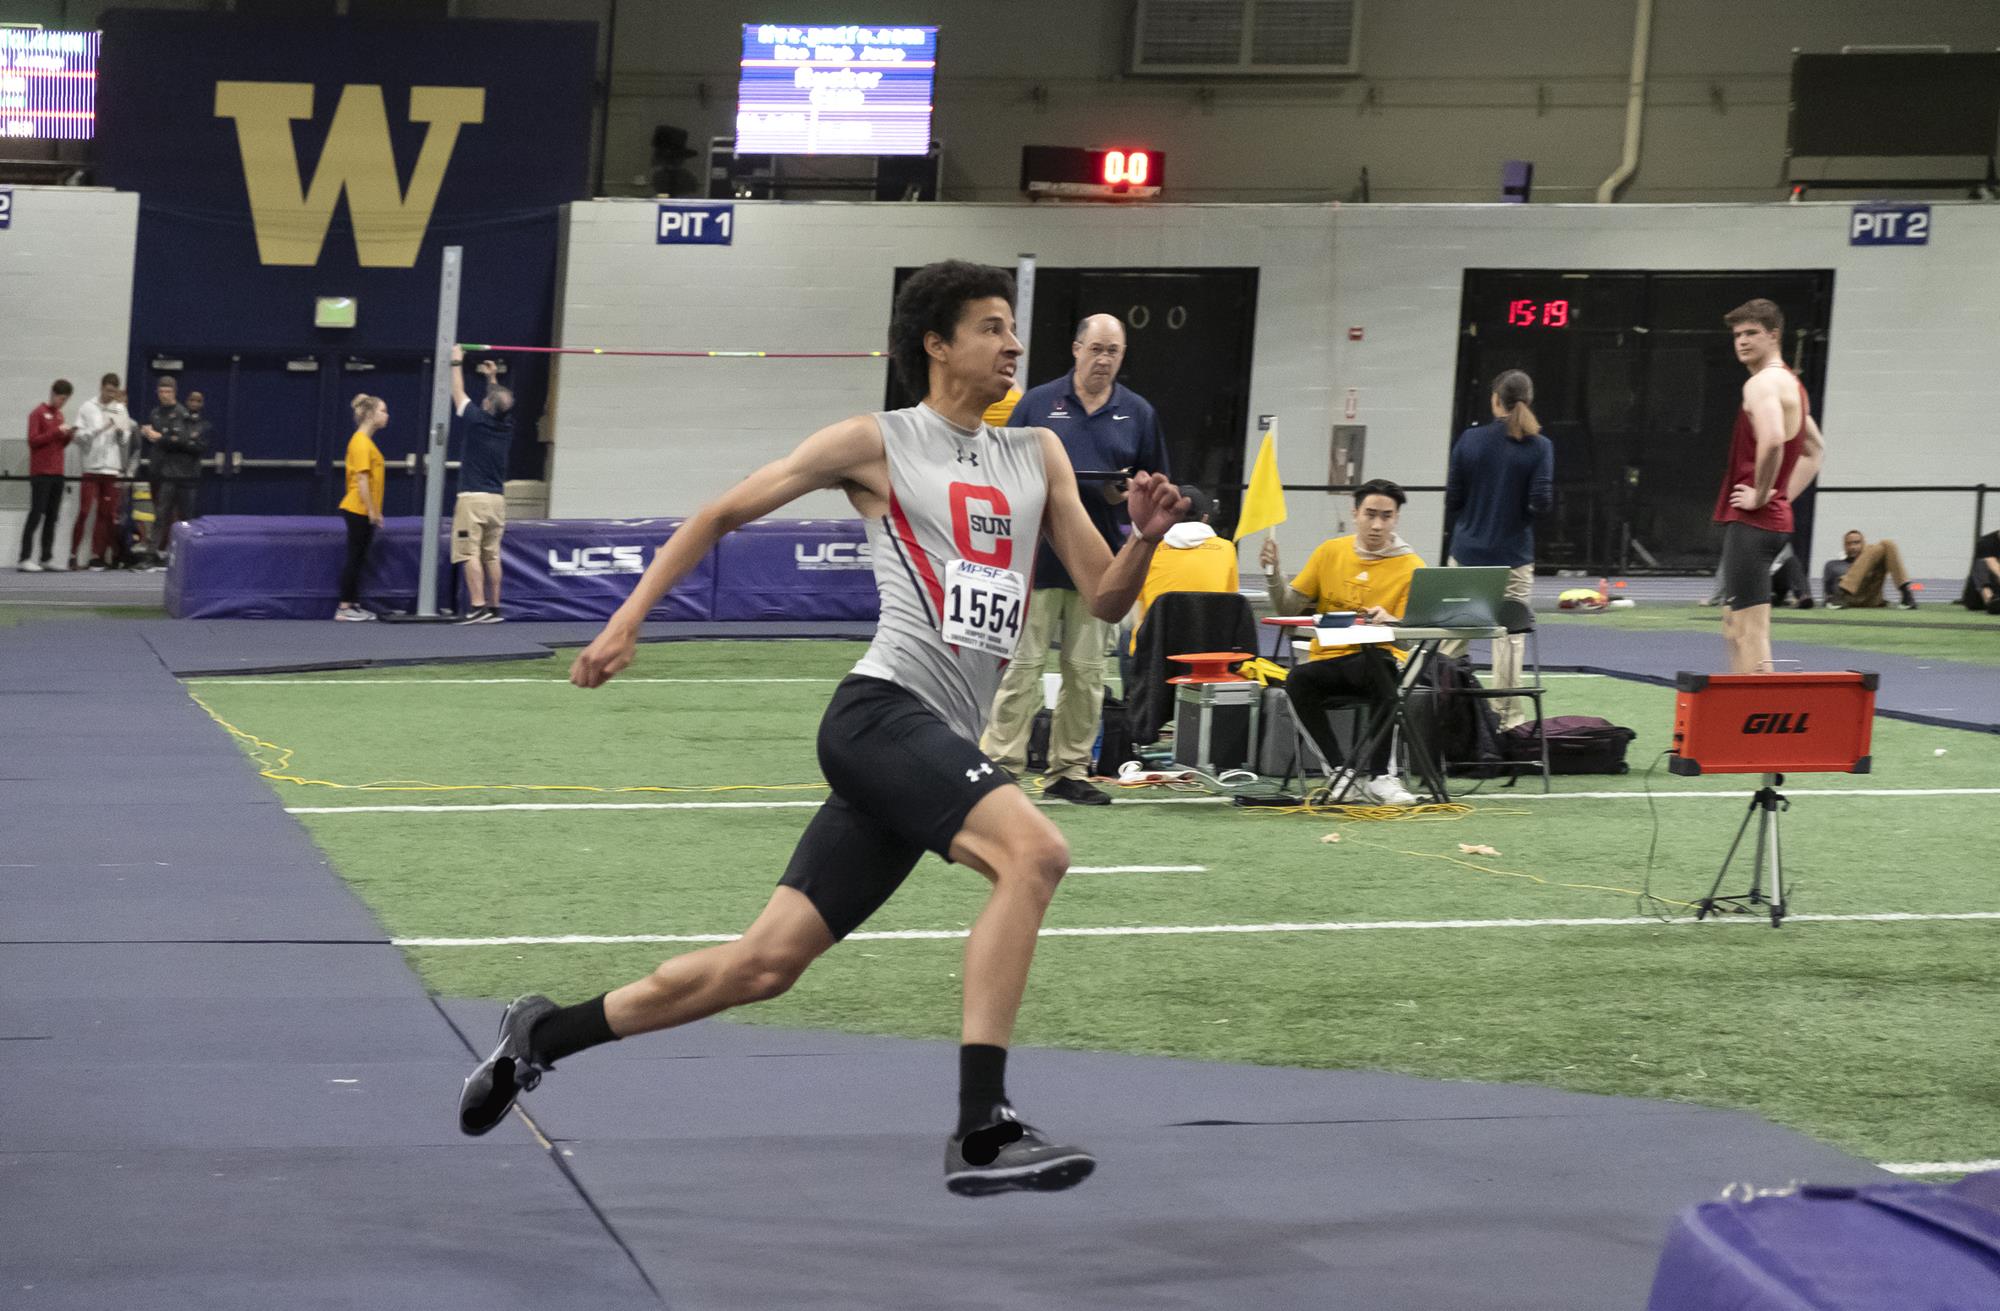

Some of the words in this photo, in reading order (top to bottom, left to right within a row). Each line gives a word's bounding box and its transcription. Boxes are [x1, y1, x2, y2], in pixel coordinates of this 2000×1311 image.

[214, 80, 486, 268] W
[660, 212, 710, 237] PIT
[715, 212, 731, 237] 1
[1852, 212, 1903, 238] PIT
[1905, 212, 1928, 238] 2
[1507, 299, 1569, 328] 15:19
[548, 546, 644, 570] UCS
[958, 561, 1003, 578] MPSF
[949, 584, 1021, 638] 1554
[1741, 713, 1809, 734] GILL
